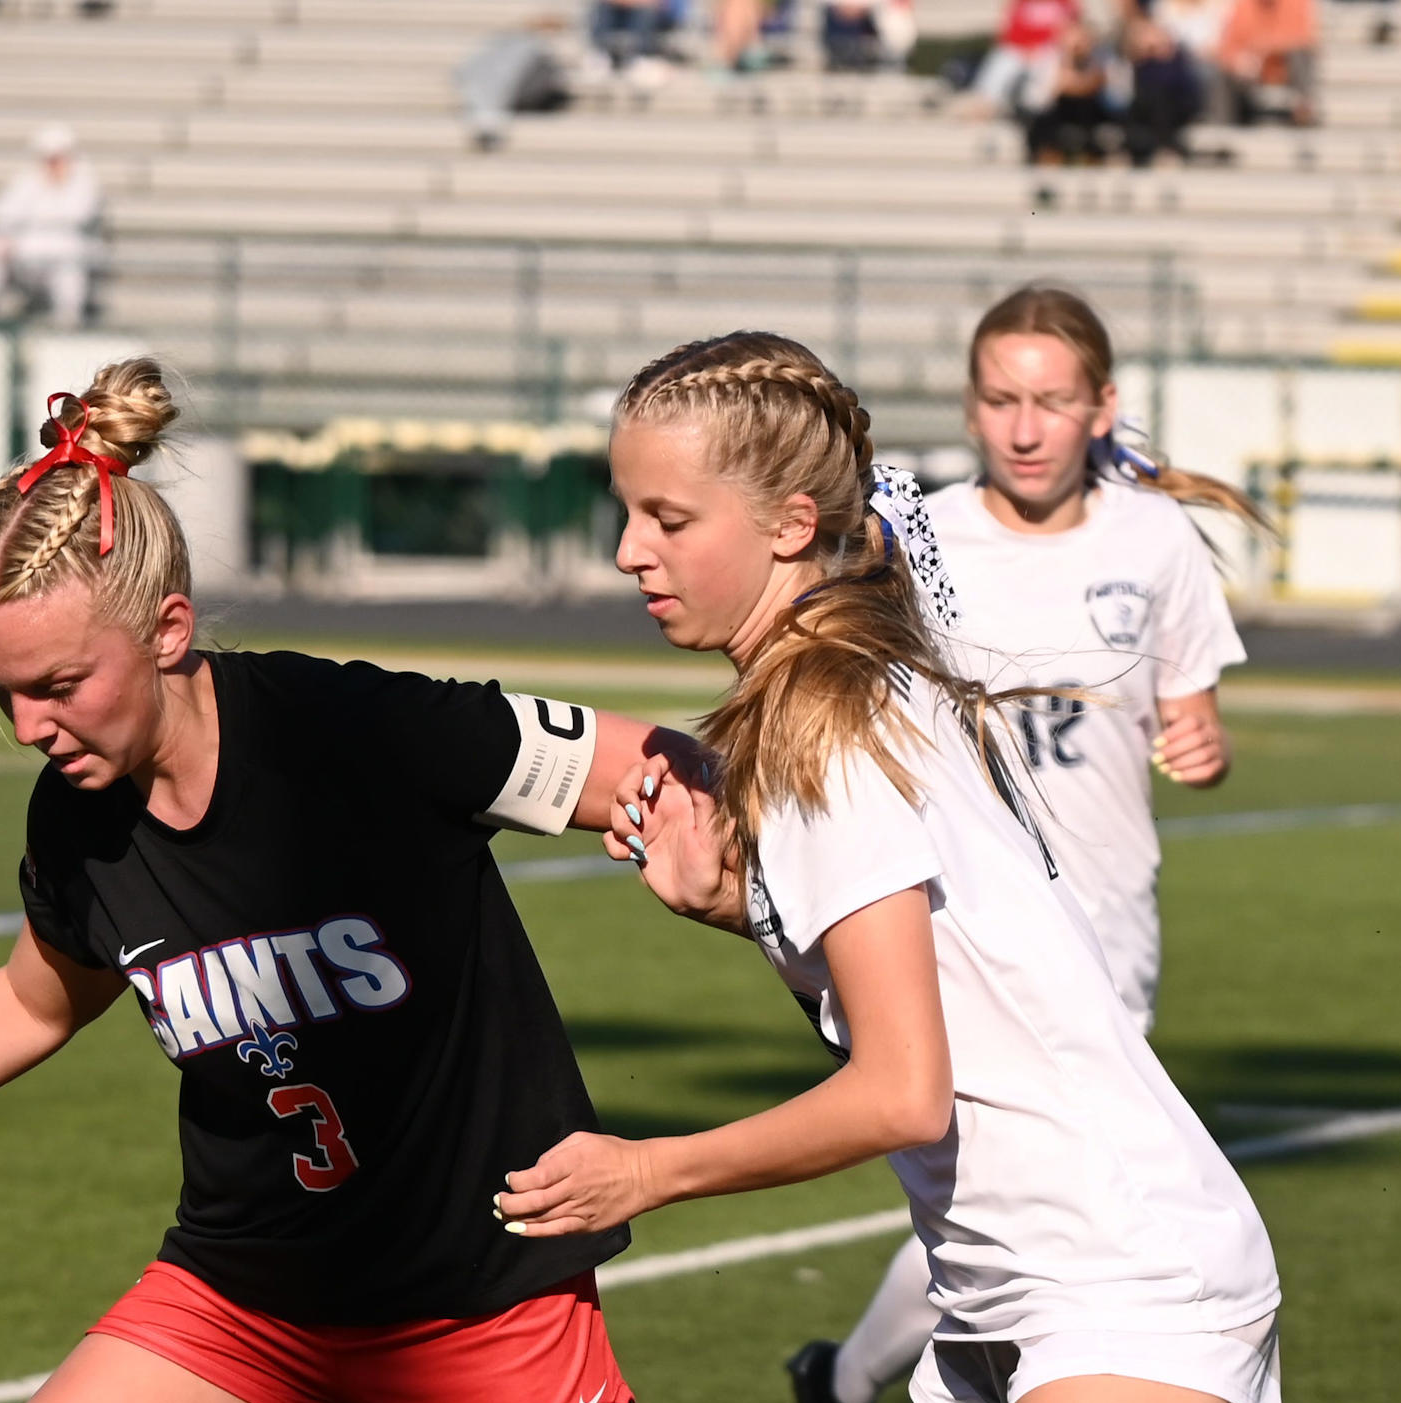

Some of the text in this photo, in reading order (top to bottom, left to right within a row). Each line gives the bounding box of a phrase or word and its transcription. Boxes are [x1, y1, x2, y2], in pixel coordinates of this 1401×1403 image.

[534, 697, 584, 741] C
[1015, 679, 1087, 769] 12
[267, 1083, 360, 1192] 3
